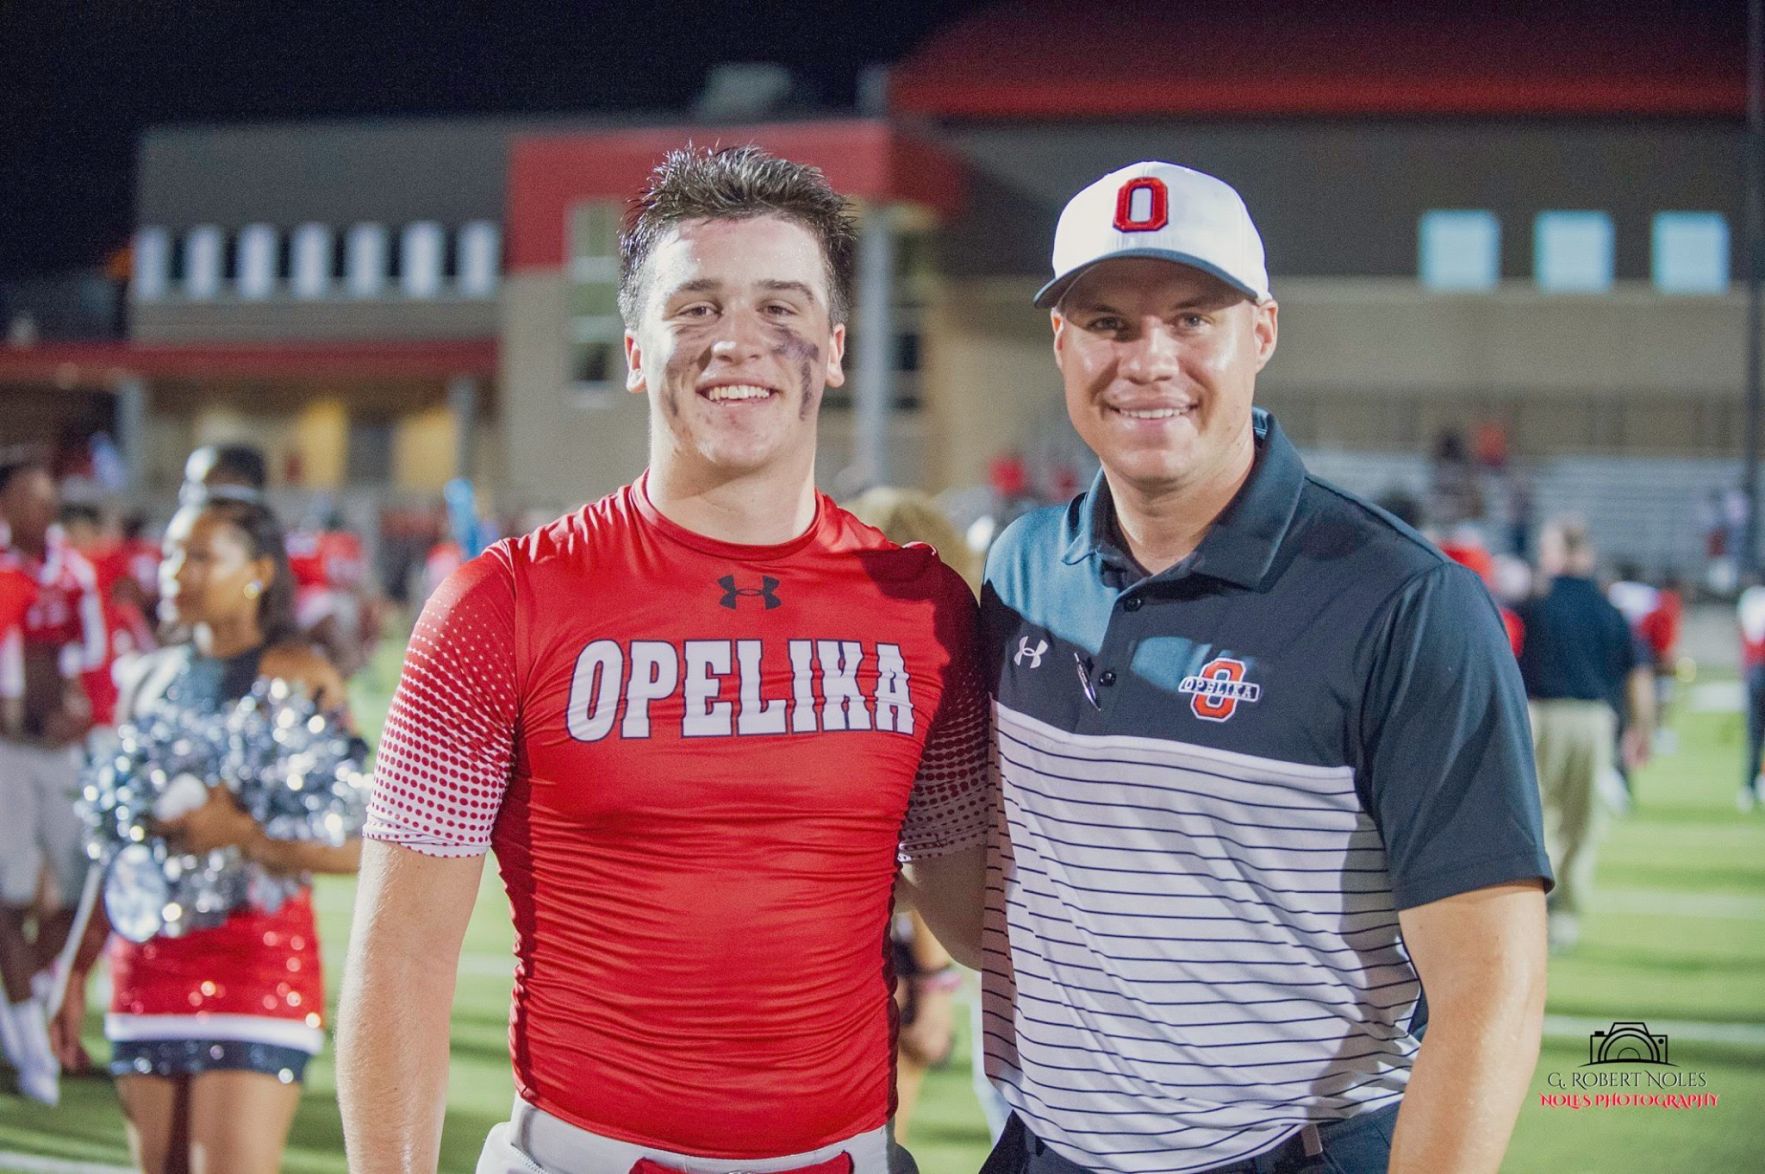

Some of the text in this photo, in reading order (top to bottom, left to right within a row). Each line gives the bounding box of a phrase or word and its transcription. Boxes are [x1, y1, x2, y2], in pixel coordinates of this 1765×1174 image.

[1113, 177, 1169, 233] O
[566, 638, 915, 742] OPELIKA
[1182, 678, 1254, 700] OPELIKA
[1190, 657, 1246, 722] O
